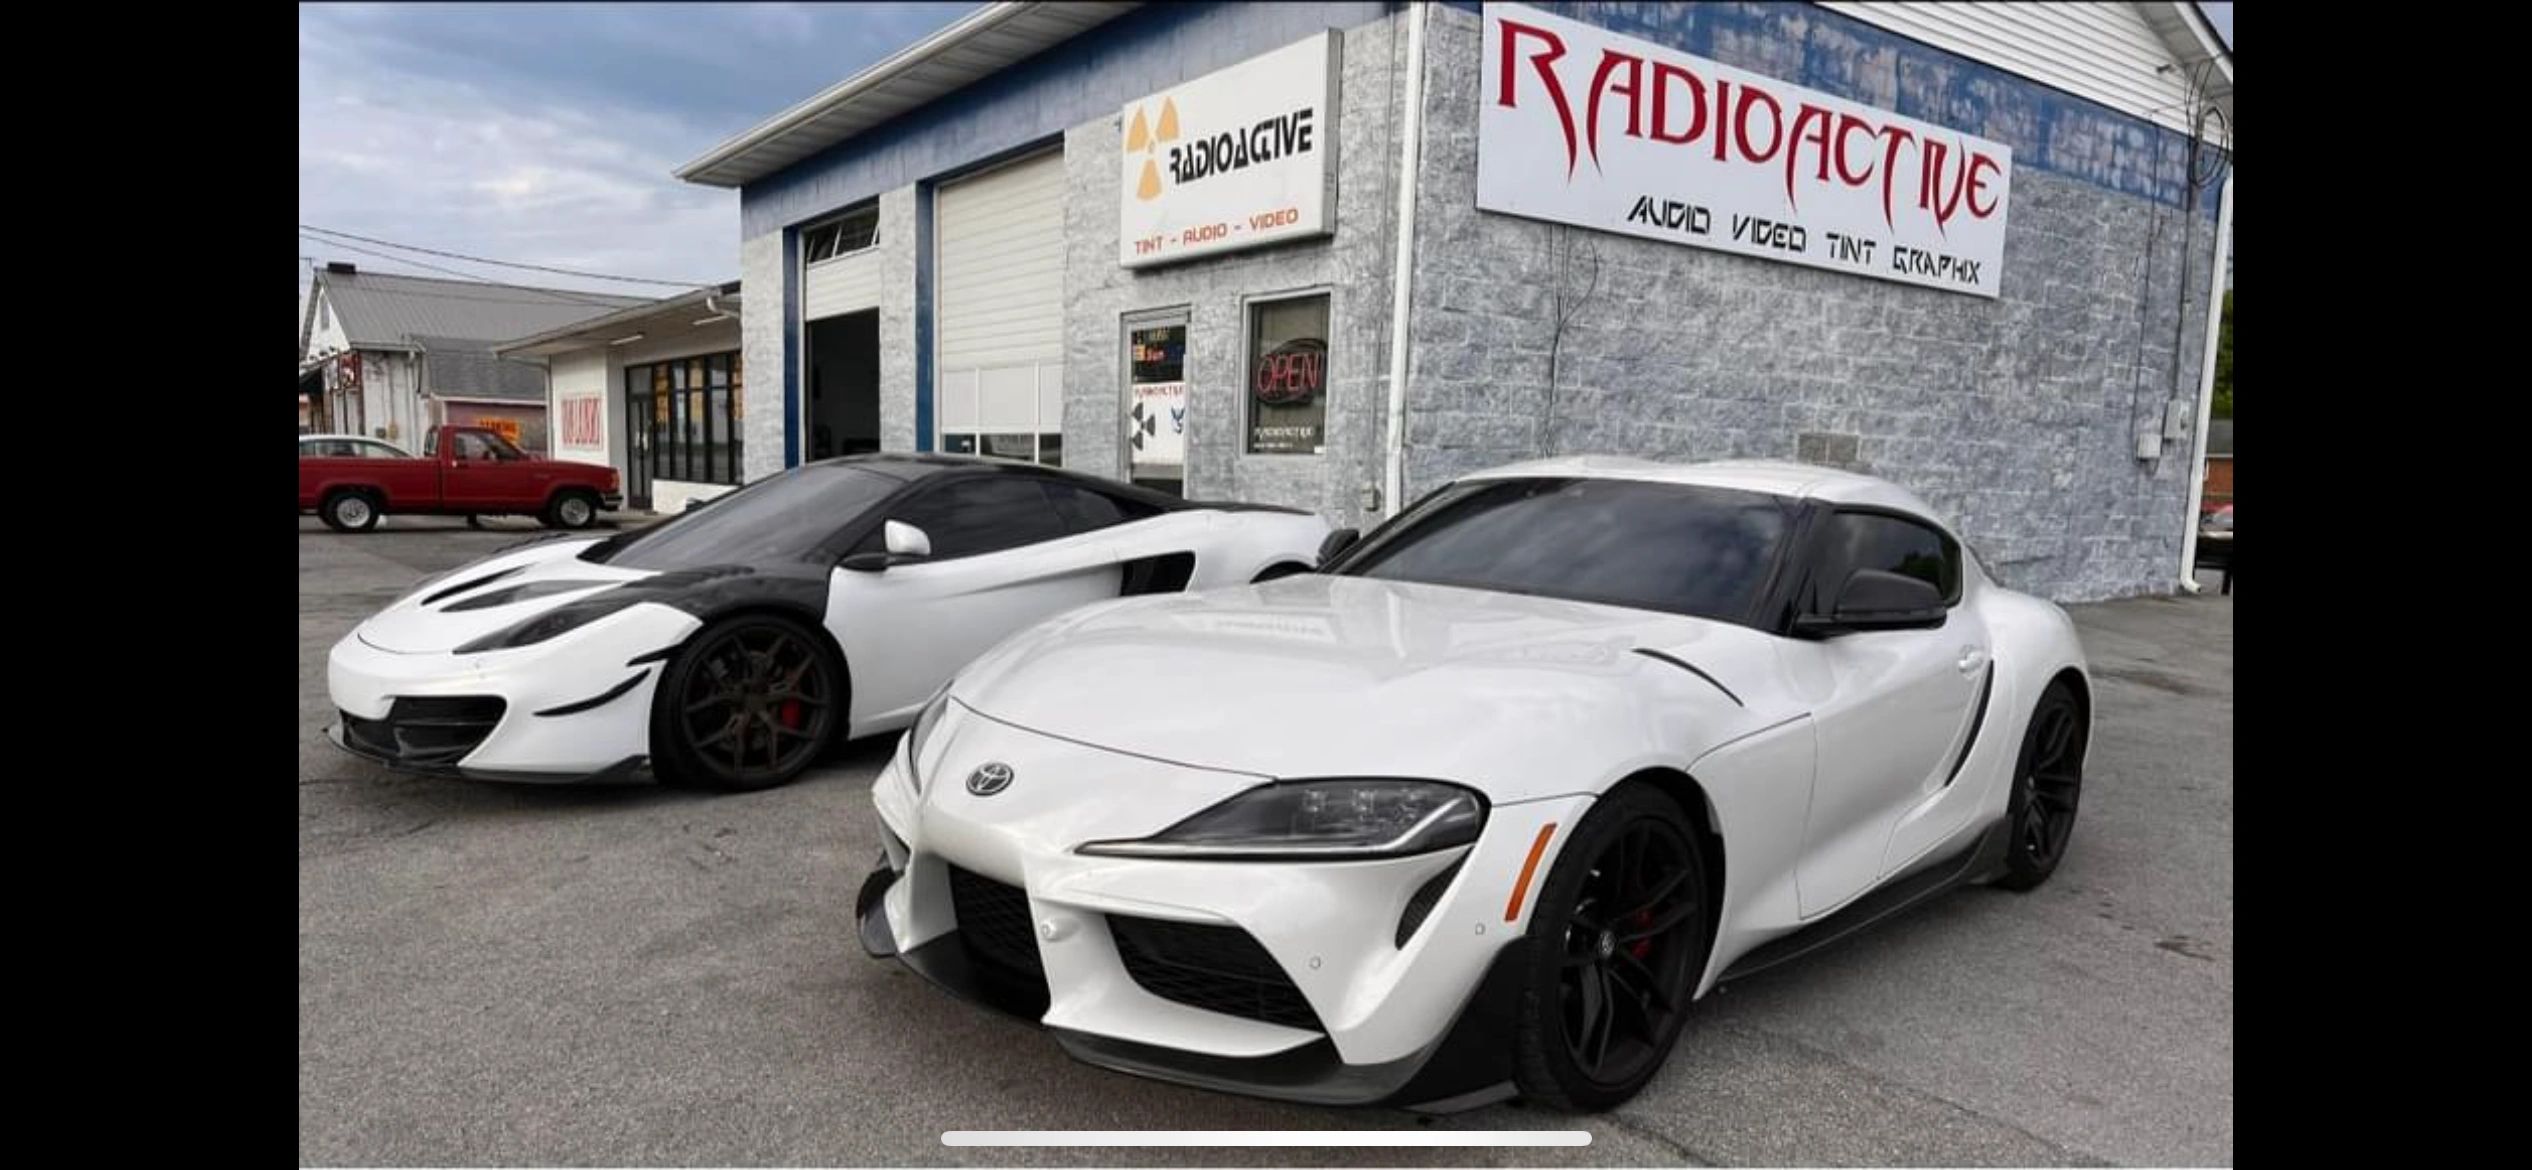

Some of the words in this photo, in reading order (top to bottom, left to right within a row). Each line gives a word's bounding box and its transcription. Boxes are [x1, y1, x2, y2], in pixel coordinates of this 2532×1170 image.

[1169, 107, 1313, 184] RADIOACTIVE
[1498, 18, 2001, 240] RADIOACTIVE
[1134, 235, 1163, 255] TINT
[1183, 223, 1227, 245] AUDIO
[1249, 208, 1299, 231] VIDEO
[1627, 195, 1710, 234] AUDIO
[1732, 214, 1806, 252] VIDEO
[1826, 233, 1876, 265] TINT
[1893, 247, 1981, 284] GRAPHIX
[1257, 352, 1320, 393] OPEN
